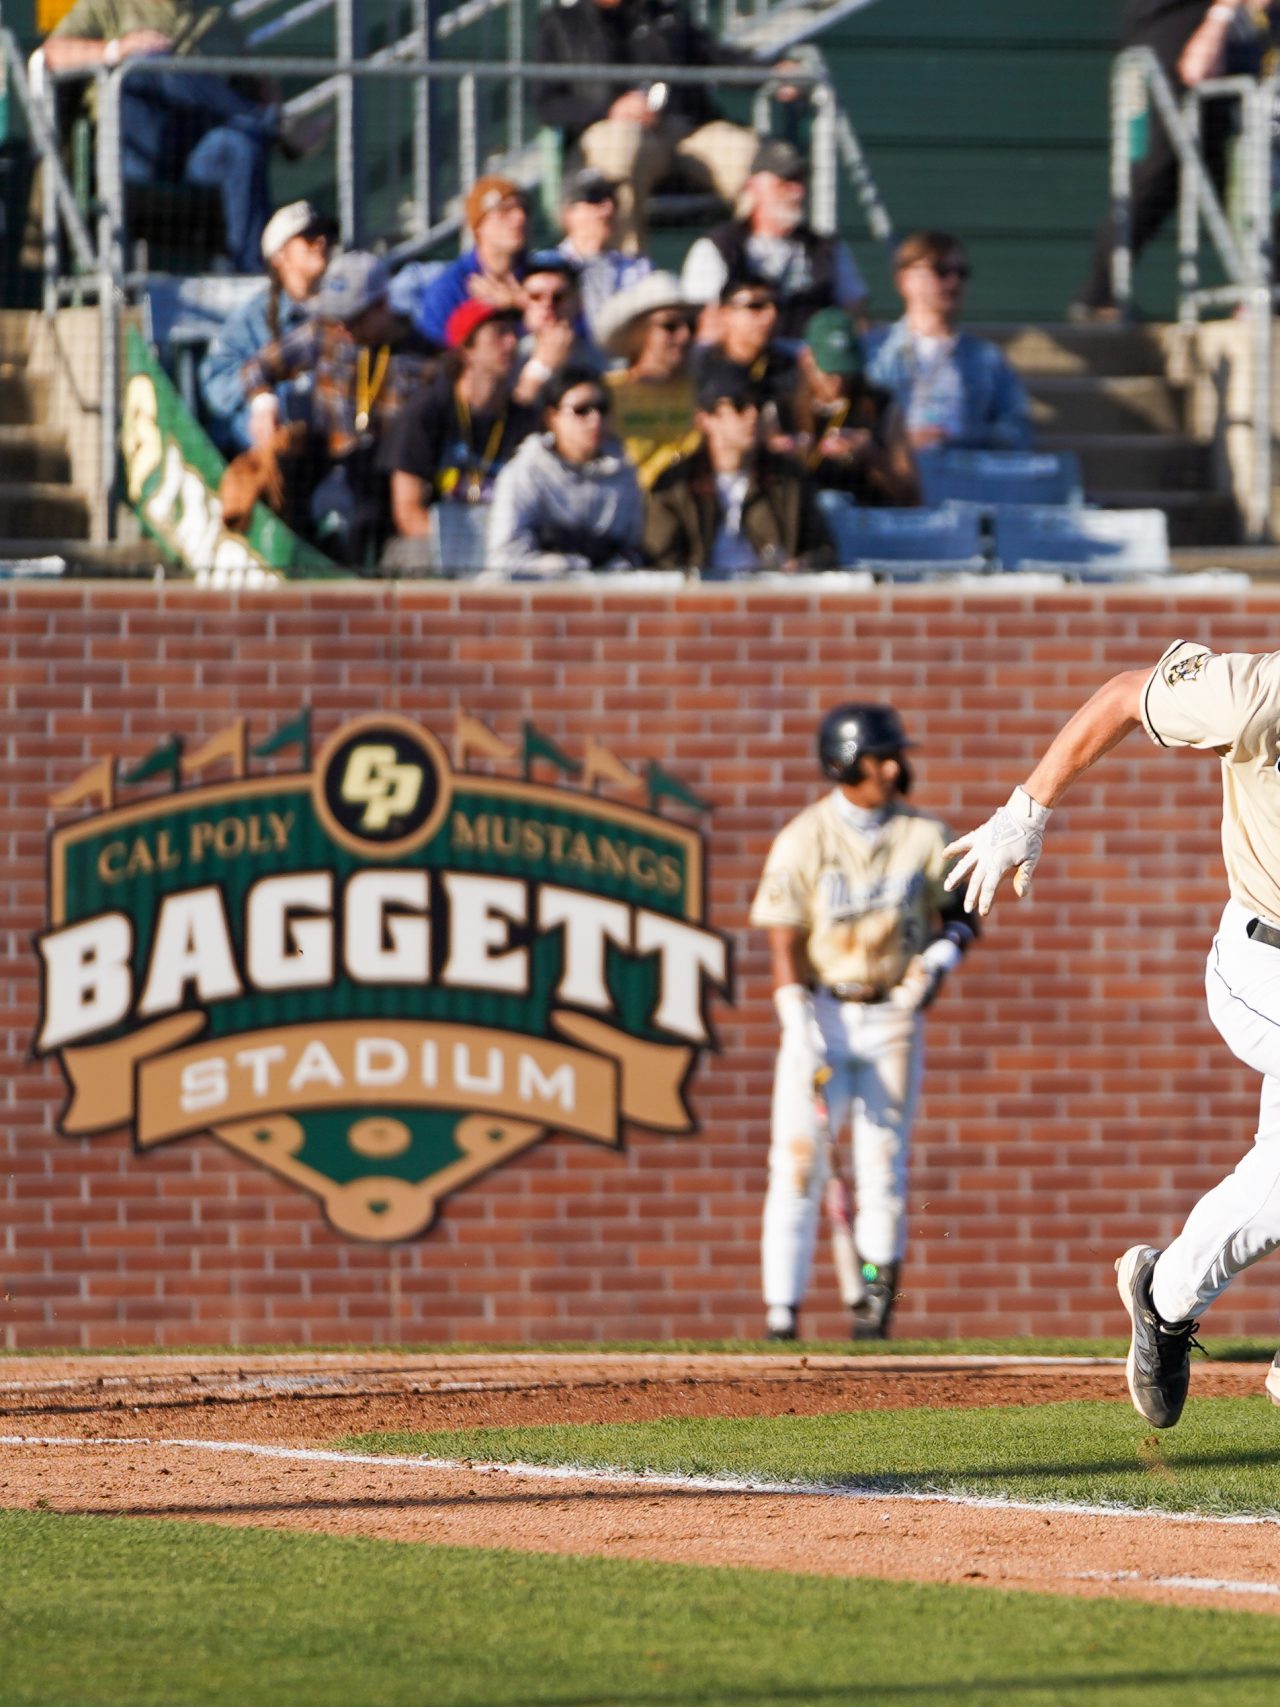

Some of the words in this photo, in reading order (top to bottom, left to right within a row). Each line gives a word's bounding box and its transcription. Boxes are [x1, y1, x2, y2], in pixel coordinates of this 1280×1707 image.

[341, 744, 423, 830] CP
[97, 834, 181, 885] CAL
[188, 811, 296, 866] POLY
[451, 811, 682, 896] MUSTANGS
[36, 868, 730, 1051] BAGGETT
[180, 1037, 576, 1113] STADIUM
